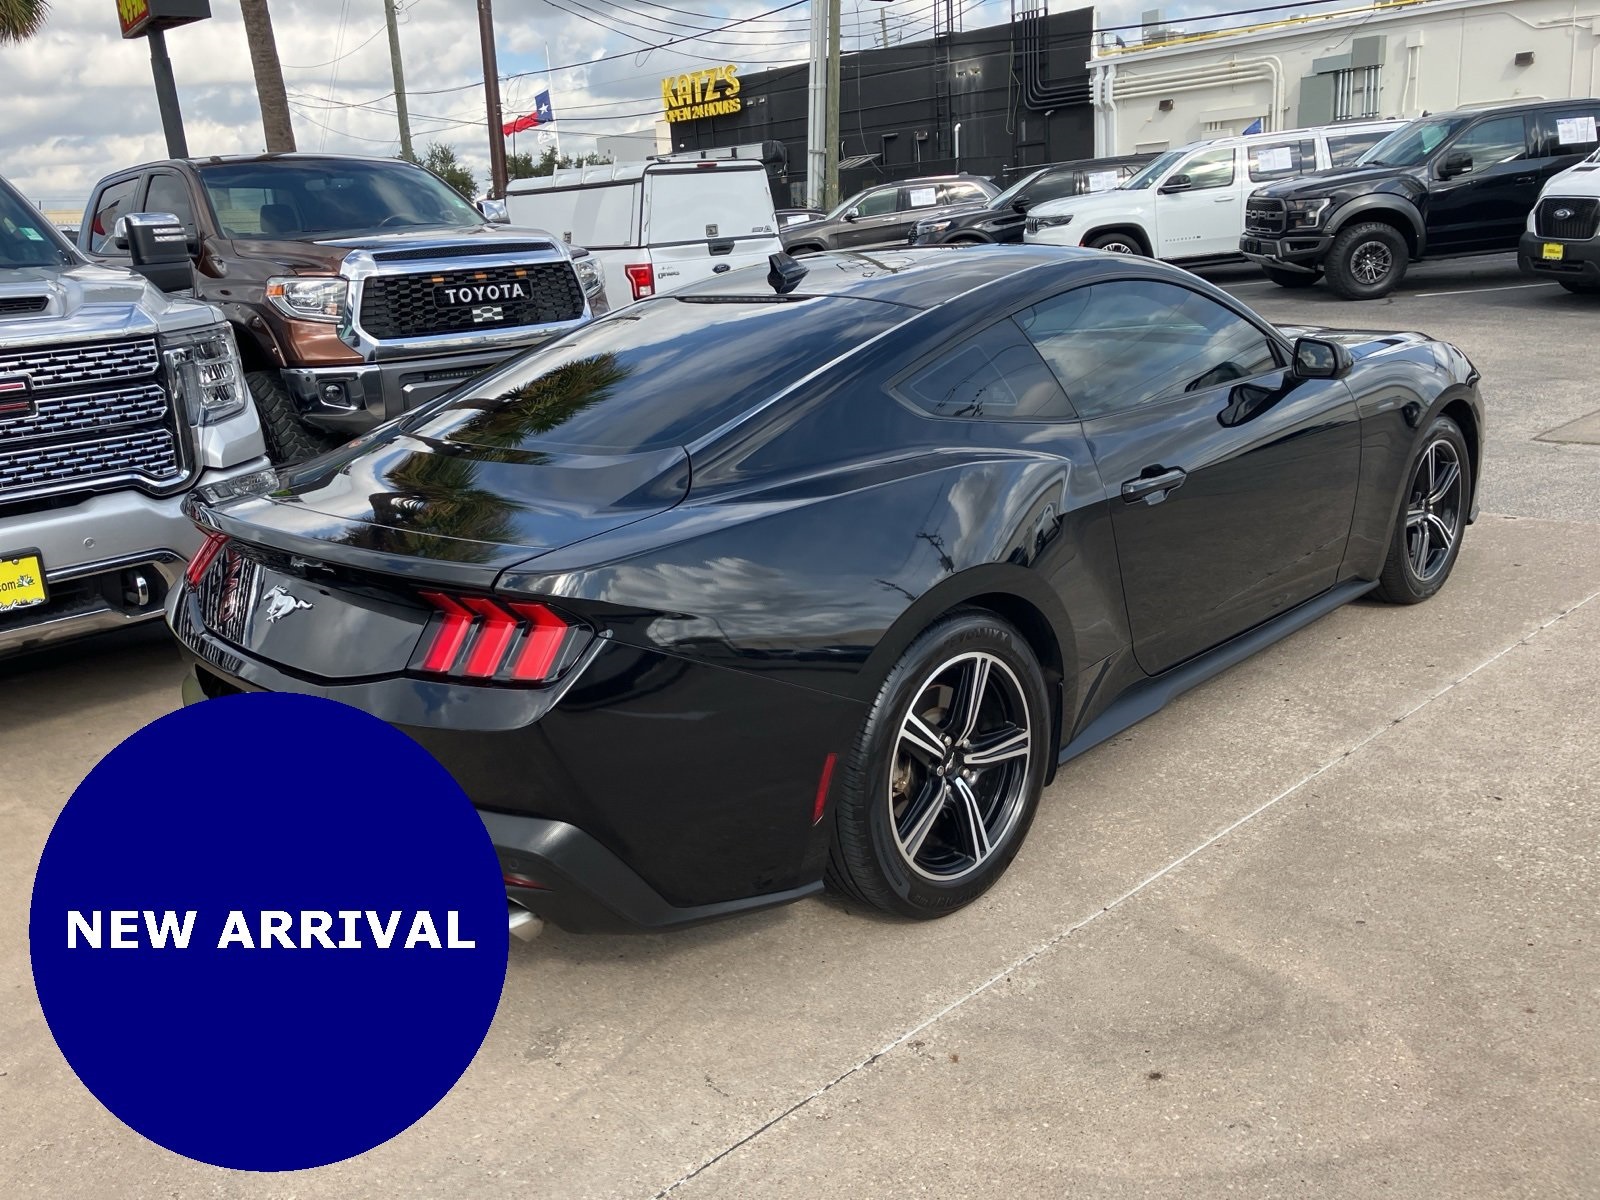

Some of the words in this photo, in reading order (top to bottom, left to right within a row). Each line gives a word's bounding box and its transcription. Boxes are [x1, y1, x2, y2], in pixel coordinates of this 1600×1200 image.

[662, 64, 741, 110] KATZ'S
[665, 106, 692, 123] OPEN
[692, 103, 705, 119] 24
[704, 98, 742, 117] HOURS
[445, 283, 524, 304] TOYOTA
